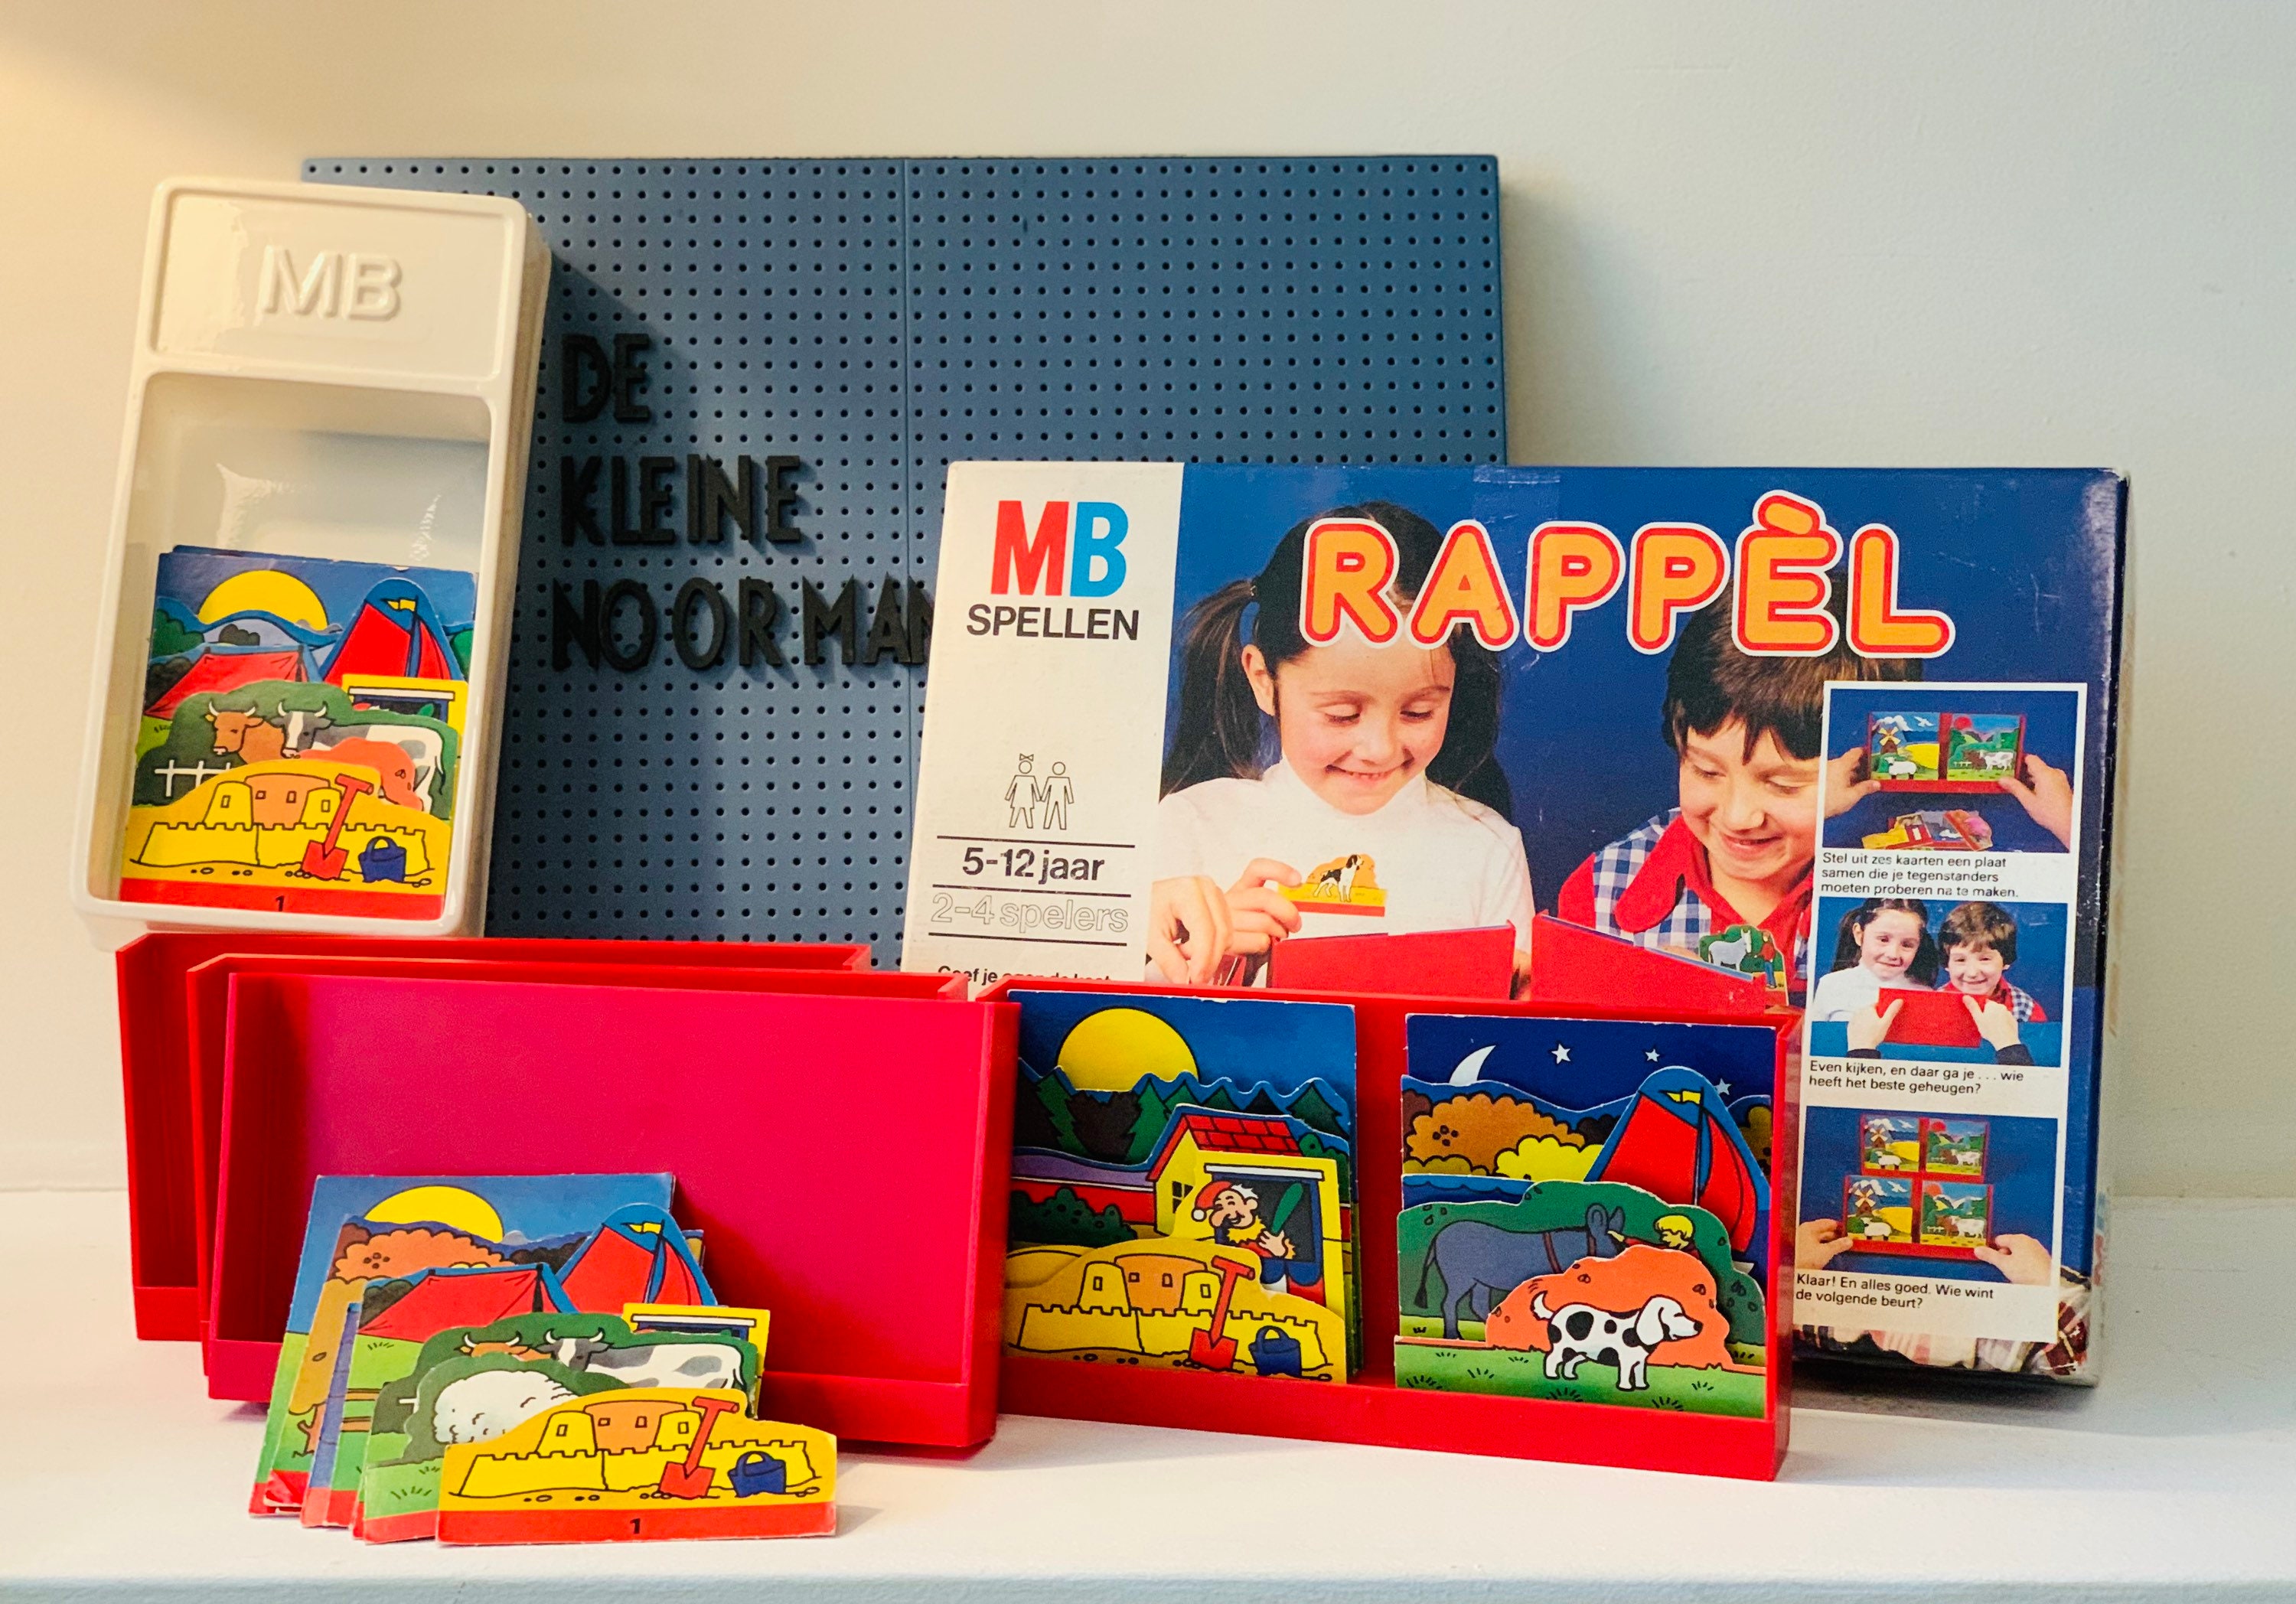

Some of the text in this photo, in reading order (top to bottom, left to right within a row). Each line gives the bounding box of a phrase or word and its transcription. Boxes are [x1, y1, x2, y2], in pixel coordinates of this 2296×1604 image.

[256, 244, 403, 322] MB
[562, 333, 651, 423] DE
[560, 454, 801, 546] KLEINE
[990, 500, 1129, 598] MB
[1300, 490, 1955, 657] RAPPÈL
[966, 604, 1140, 641] SPELLEN
[962, 846, 1105, 885] 5-12 jaar
[1822, 852, 2007, 869] Stel uit zes kaarten een plaat
[1821, 868, 1999, 883] samen die je tegenstanders
[1821, 882, 2020, 898] moeten proberen na te maken.
[276, 895, 285, 912] 1
[931, 892, 1129, 934] 2-4 spelers
[982, 967, 998, 986] je
[1809, 1060, 1842, 1072] Even
[1845, 1062, 1887, 1077] kijken,
[1890, 1066, 1906, 1076] en
[1910, 1065, 1940, 1077] daar
[1942, 1068, 1959, 1080] ga
[1962, 1067, 1975, 1081] je
[2000, 1069, 2025, 1082] wie
[1808, 1075, 1981, 1096] heeft het beste geheugen?
[1796, 1273, 1836, 1287] Klaar!
[1840, 1276, 1857, 1289] En
[1861, 1278, 1891, 1292] alles
[1936, 1283, 1962, 1297] Wie
[1965, 1286, 1994, 1299] wint
[1795, 1288, 1923, 1309] de volgende beurt?
[629, 1518, 641, 1534] 1
